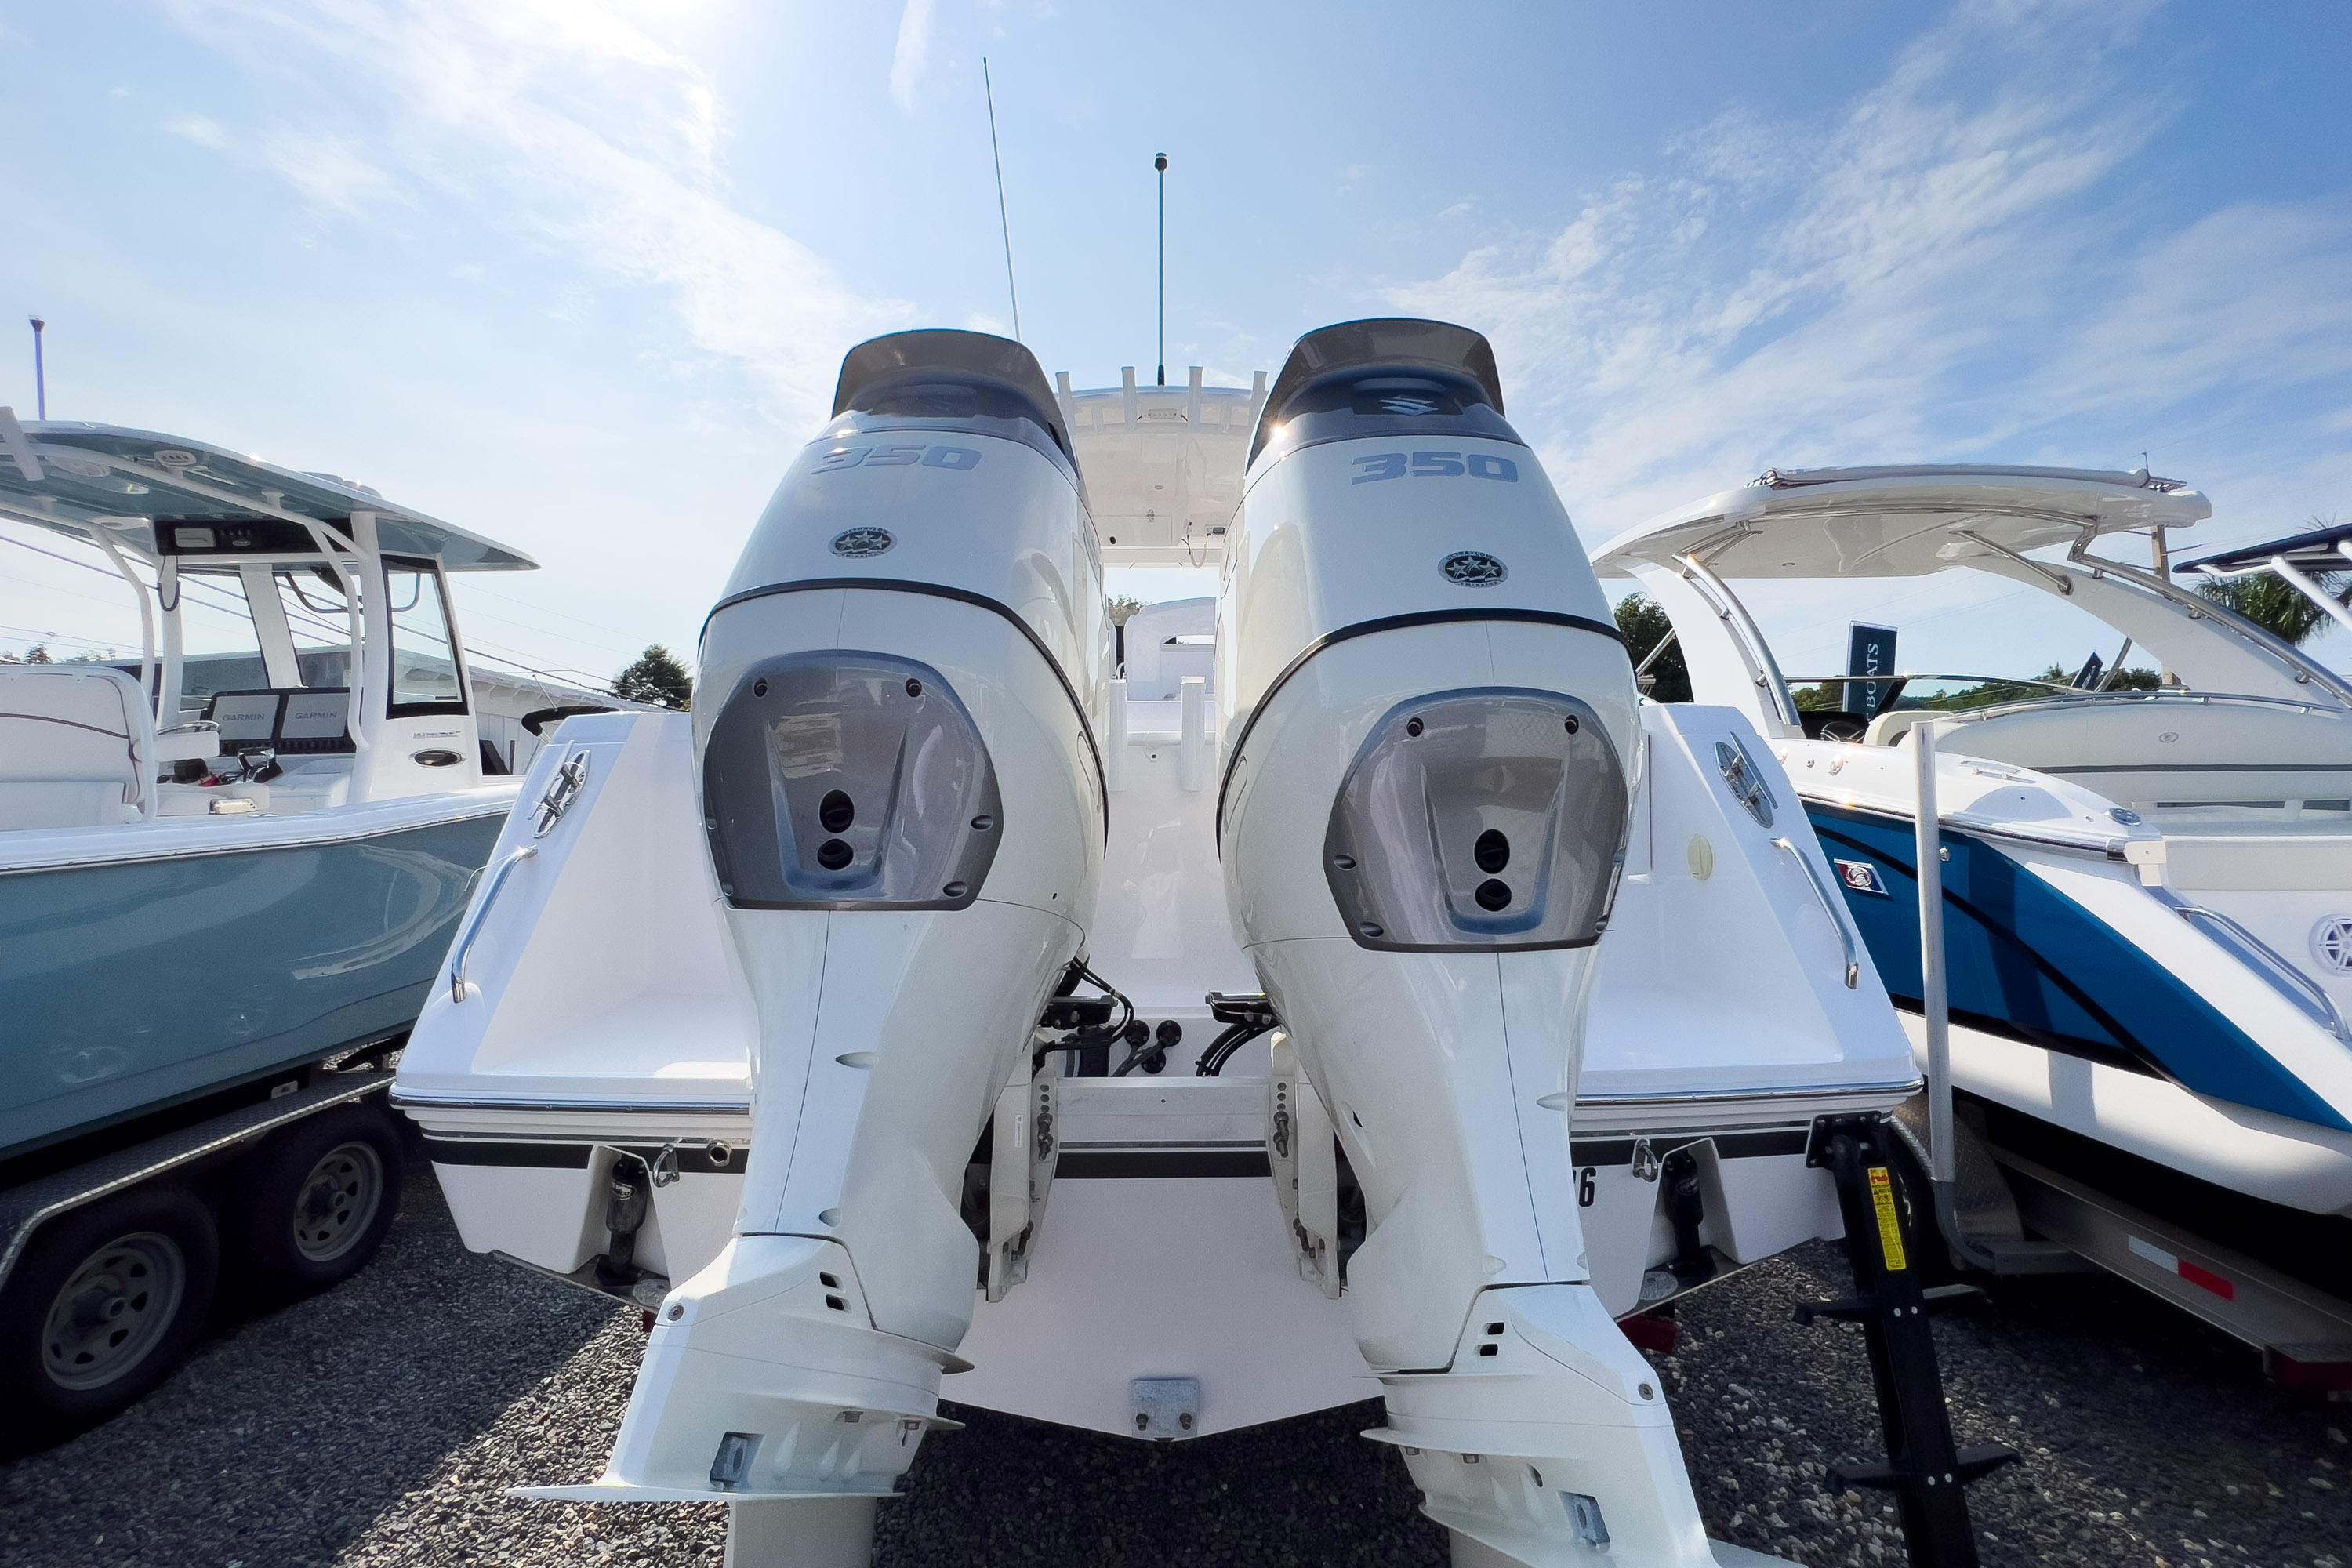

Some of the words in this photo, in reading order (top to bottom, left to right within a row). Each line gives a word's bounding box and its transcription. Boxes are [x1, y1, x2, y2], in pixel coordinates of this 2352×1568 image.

[811, 445, 982, 474] 350
[1351, 452, 1518, 485] 350
[1866, 643, 1878, 708] BOATS
[1573, 1167, 1596, 1207] 6
